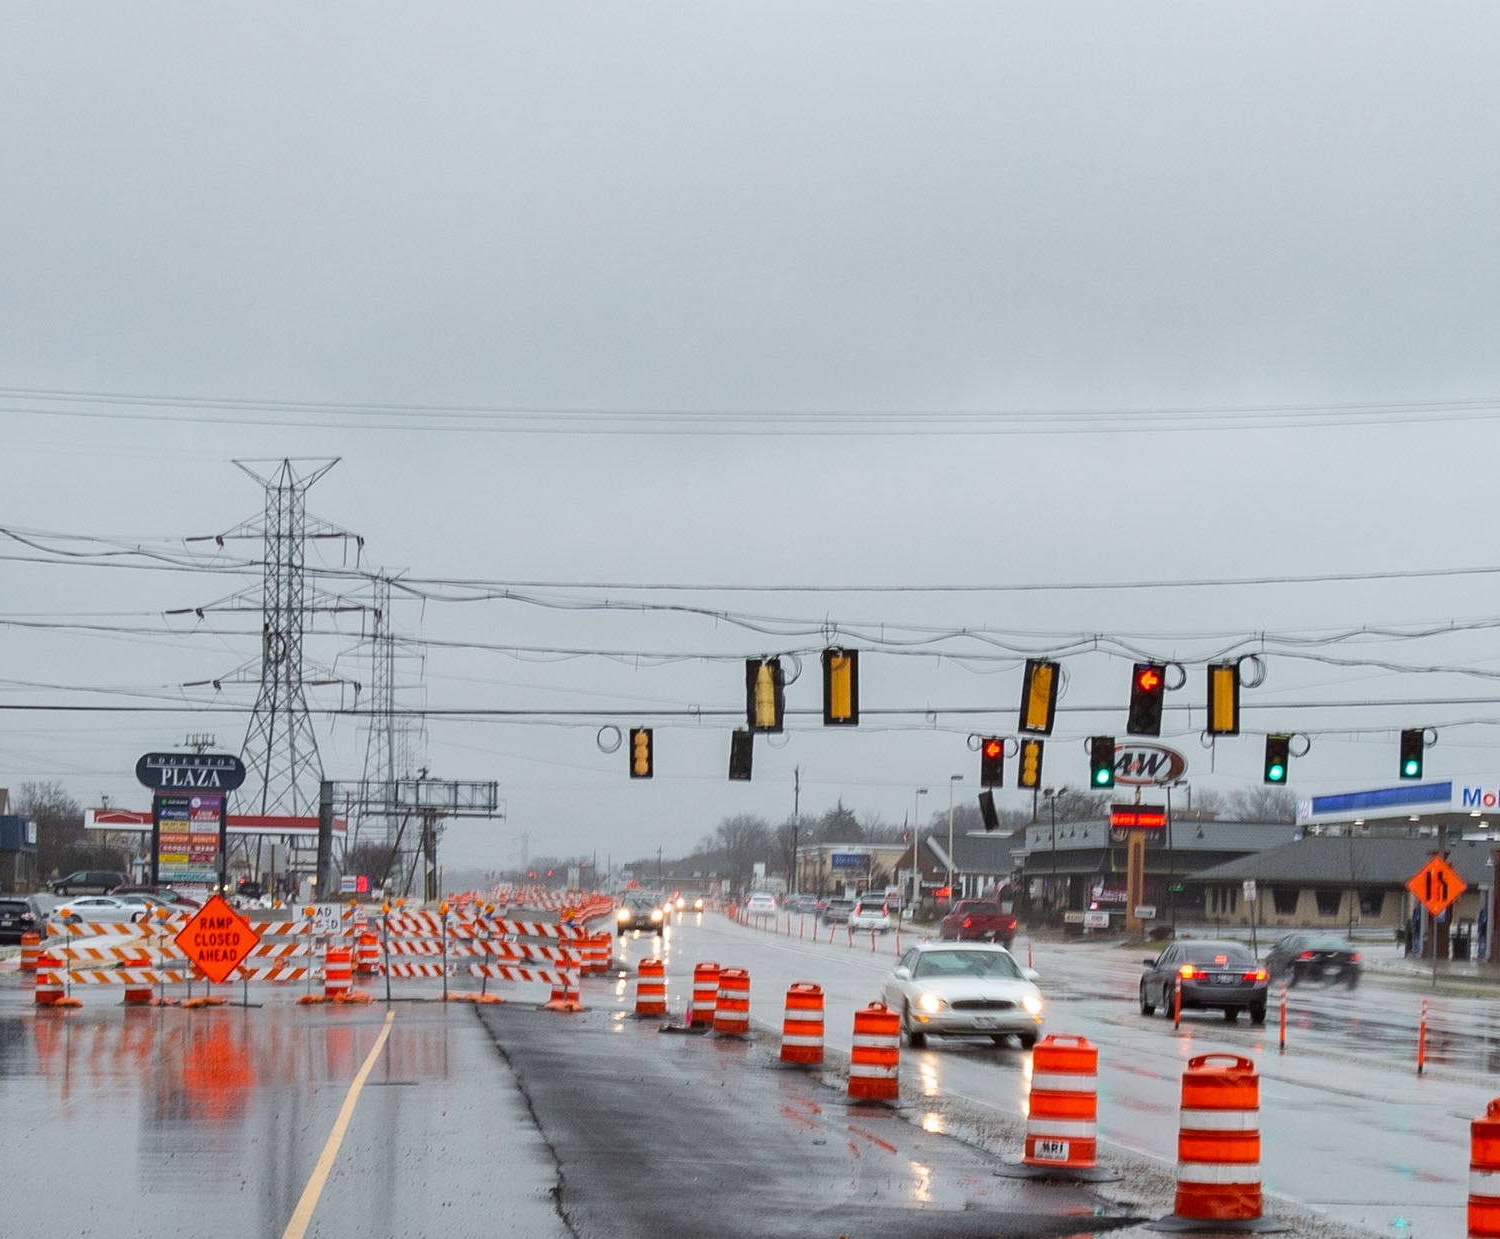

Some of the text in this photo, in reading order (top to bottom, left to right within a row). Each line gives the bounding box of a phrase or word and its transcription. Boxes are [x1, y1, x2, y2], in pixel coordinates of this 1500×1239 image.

[161, 768, 220, 787] PLAZA
[200, 917, 233, 930] RAMP
[195, 932, 240, 947] CLOSED
[198, 949, 237, 962] AHEAD
